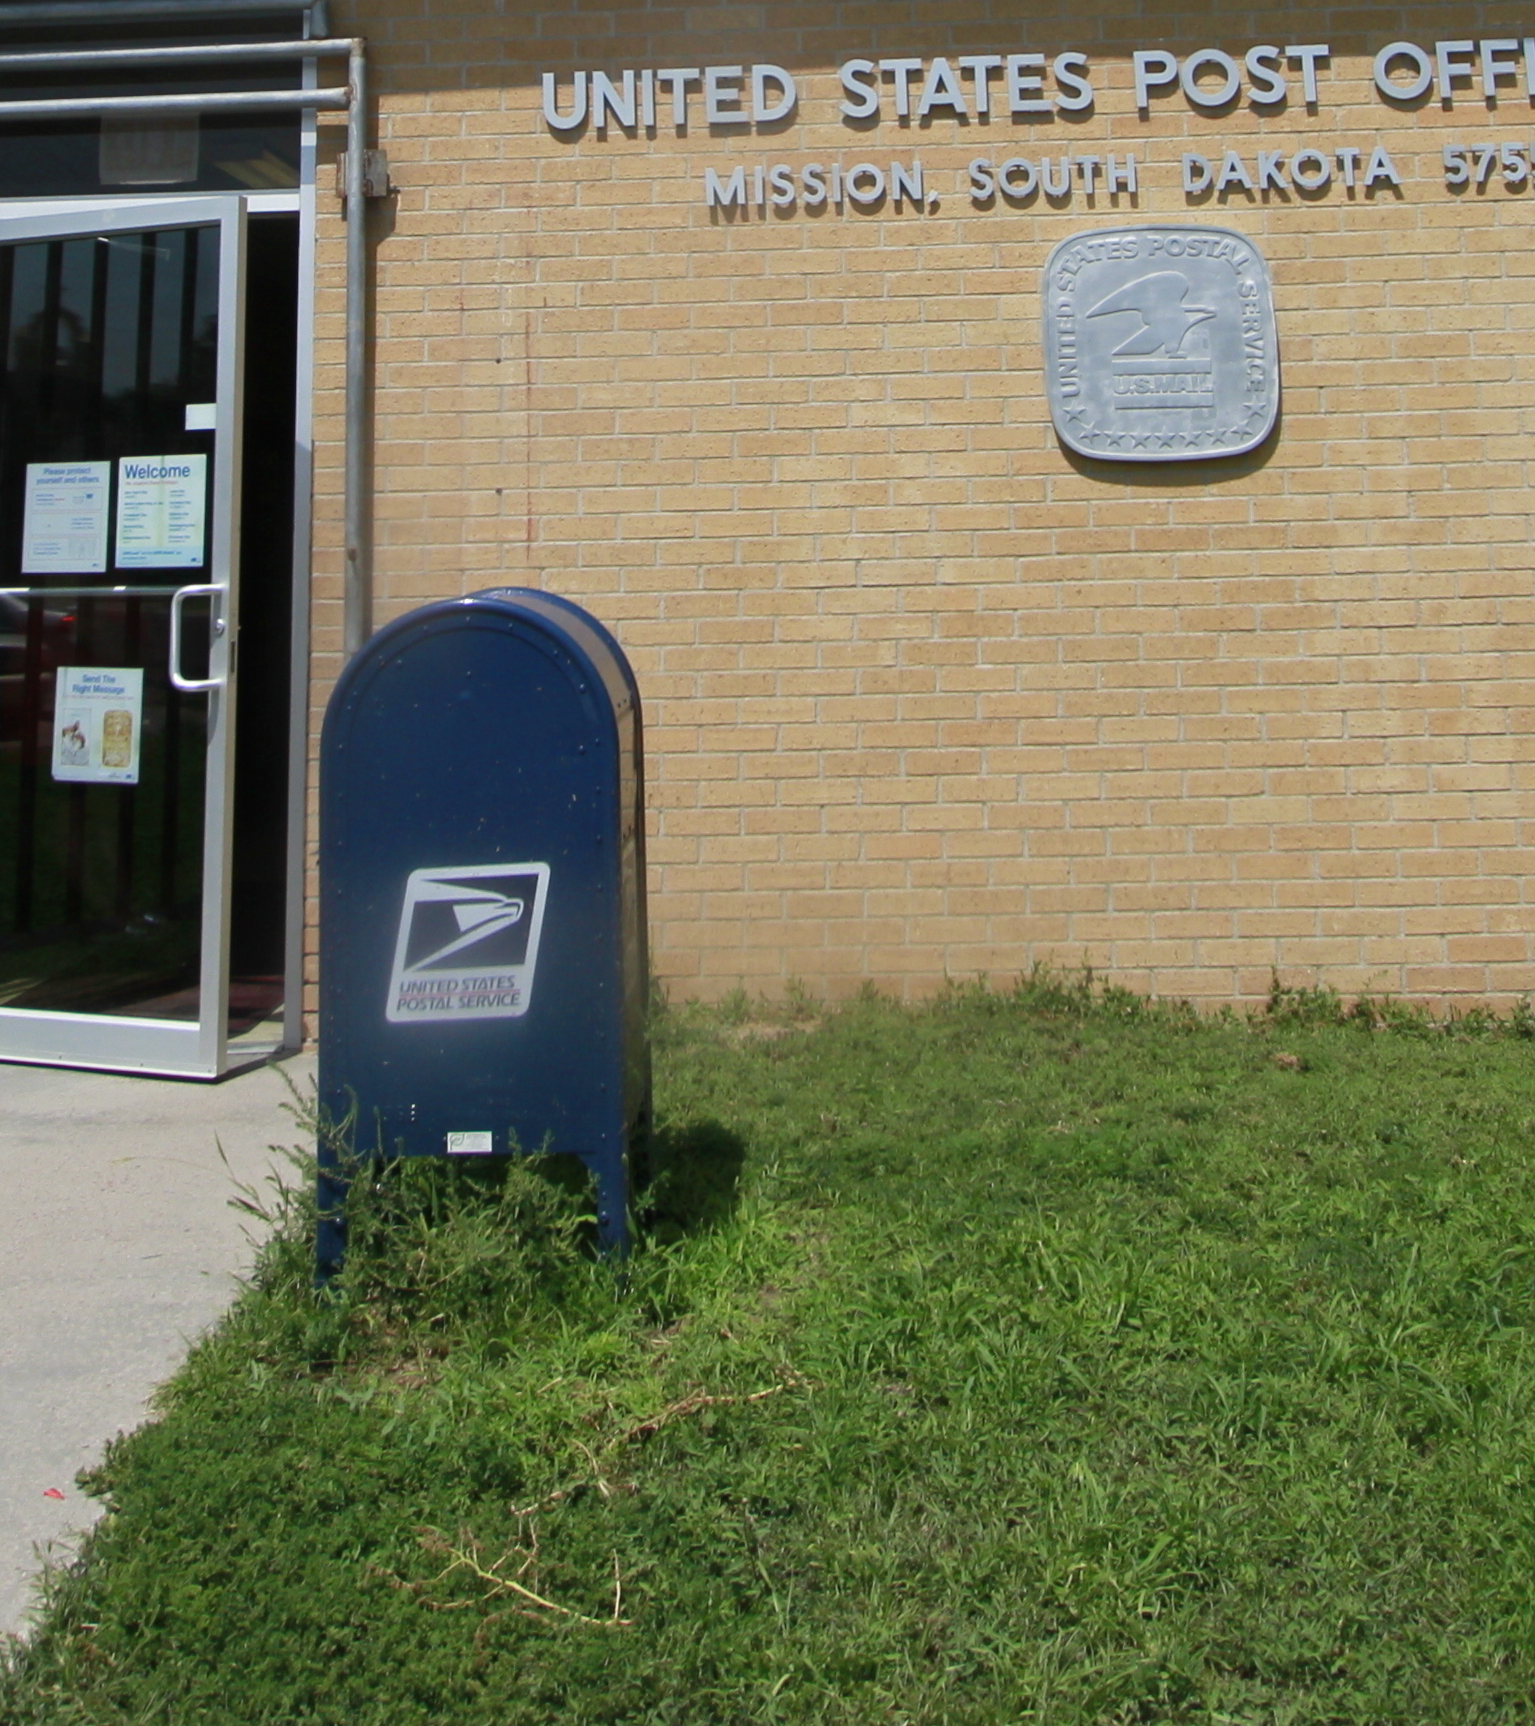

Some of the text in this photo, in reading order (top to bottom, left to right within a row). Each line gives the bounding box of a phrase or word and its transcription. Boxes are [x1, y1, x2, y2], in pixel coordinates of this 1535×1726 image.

[542, 64, 798, 131] UNITED
[839, 52, 1094, 119] STATES
[1133, 44, 1330, 109] POST
[705, 161, 939, 208] MISSION,
[969, 153, 1137, 199] SOUTH
[1182, 146, 1404, 193] DAKOTA
[1056, 235, 1265, 399] UNITED STATES POSTAL SERVICE
[124, 464, 191, 479] Welcome
[396, 993, 521, 1012] POSTAL SERVICE
[400, 975, 516, 993] UNITED STATES
